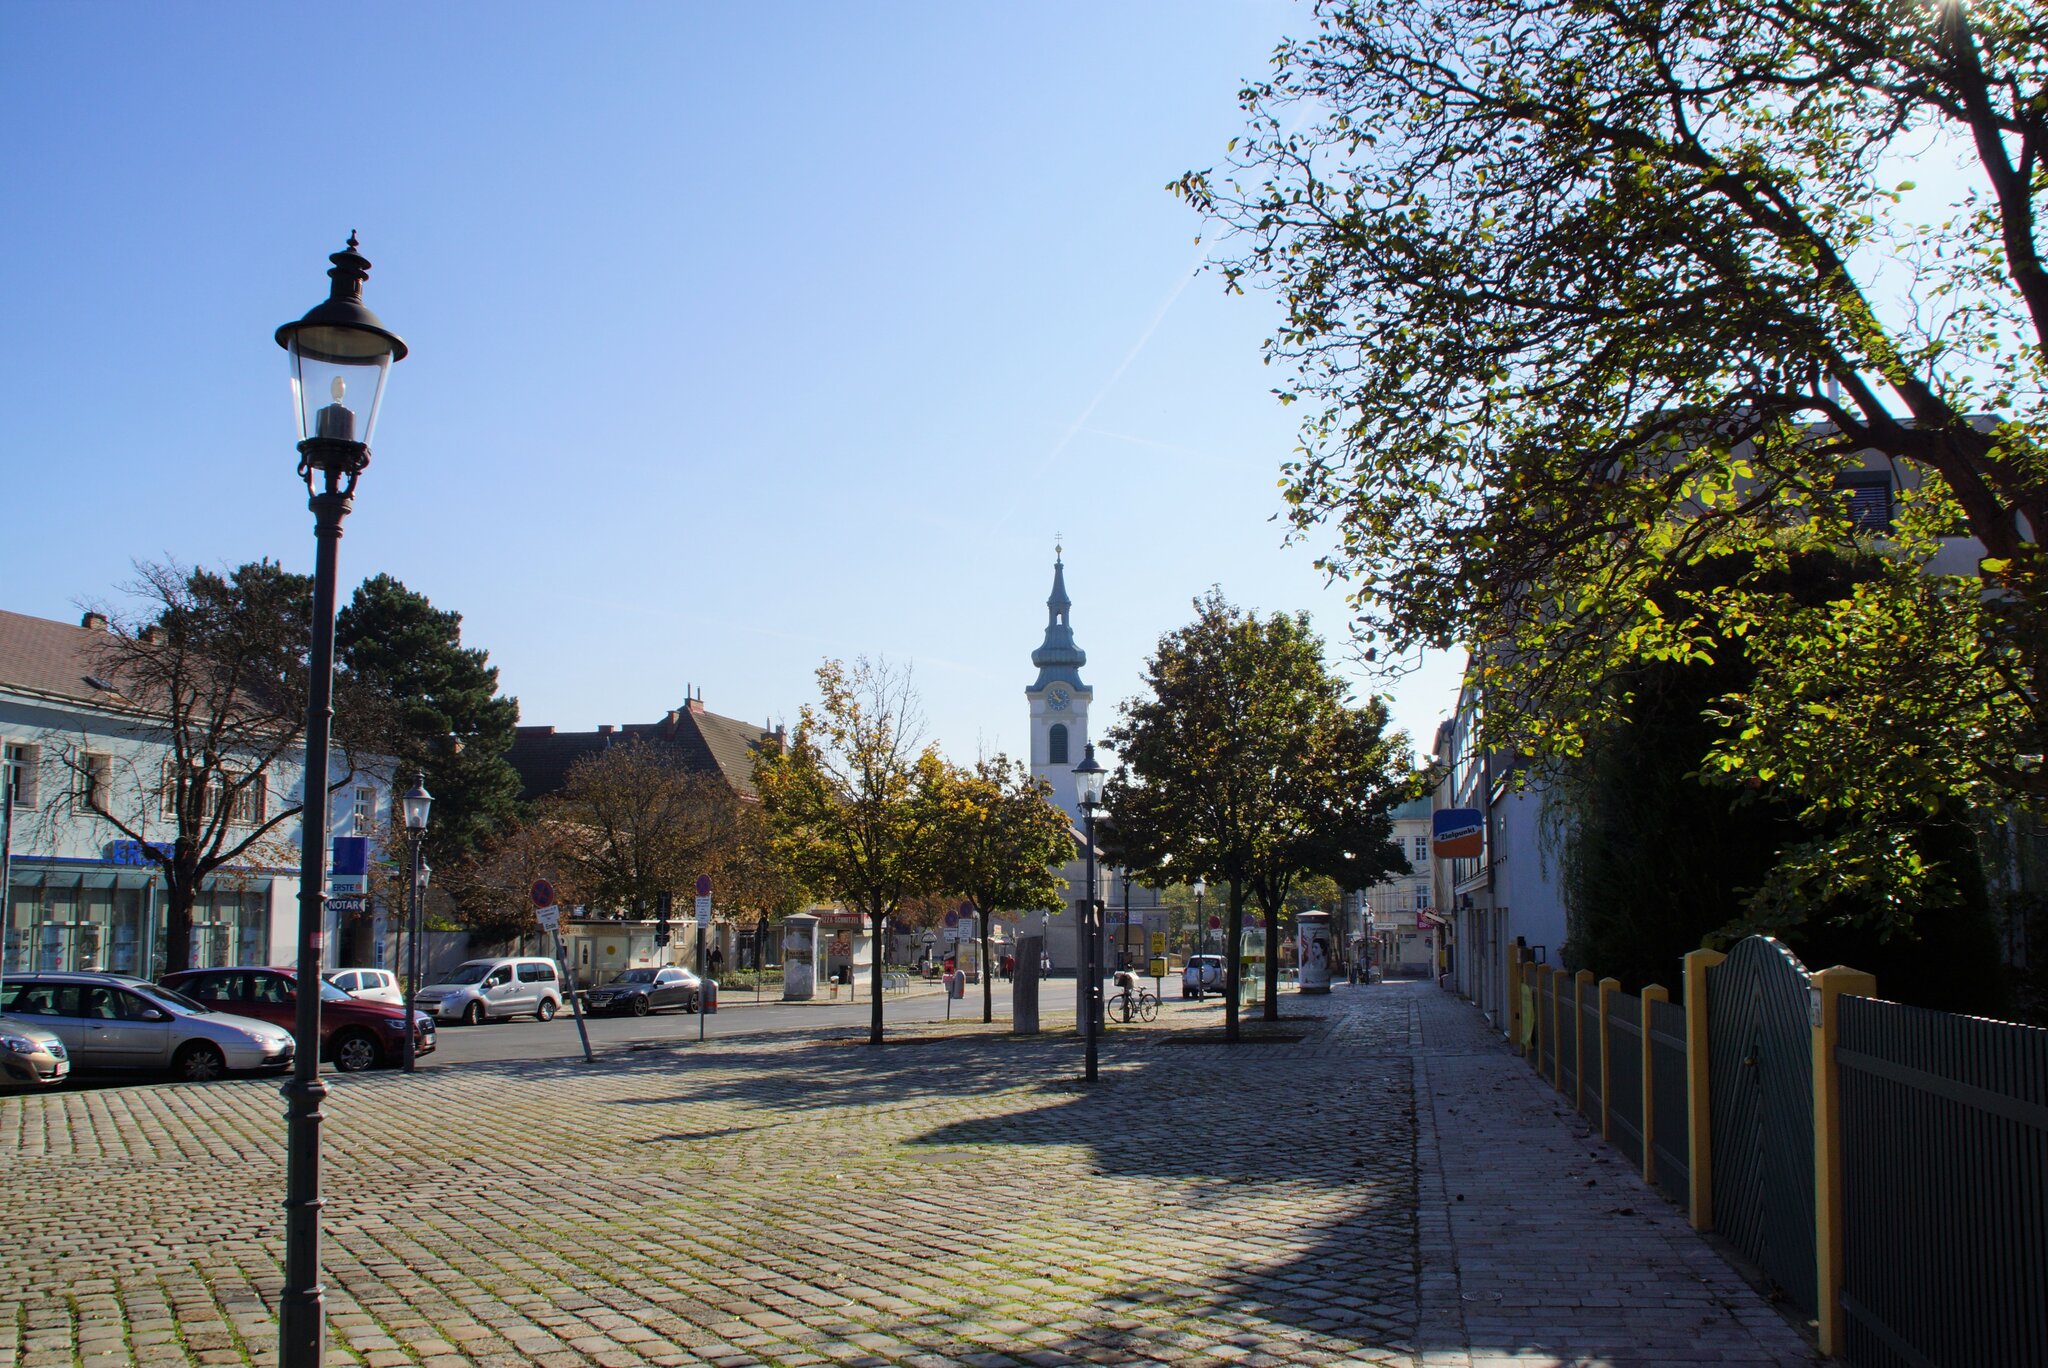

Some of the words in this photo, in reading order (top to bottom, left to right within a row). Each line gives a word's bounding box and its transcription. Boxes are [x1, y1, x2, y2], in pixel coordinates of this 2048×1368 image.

[1440, 827, 1476, 840] Zielpunkt
[332, 883, 355, 892] ERSTE
[328, 900, 360, 910] NOTAR
